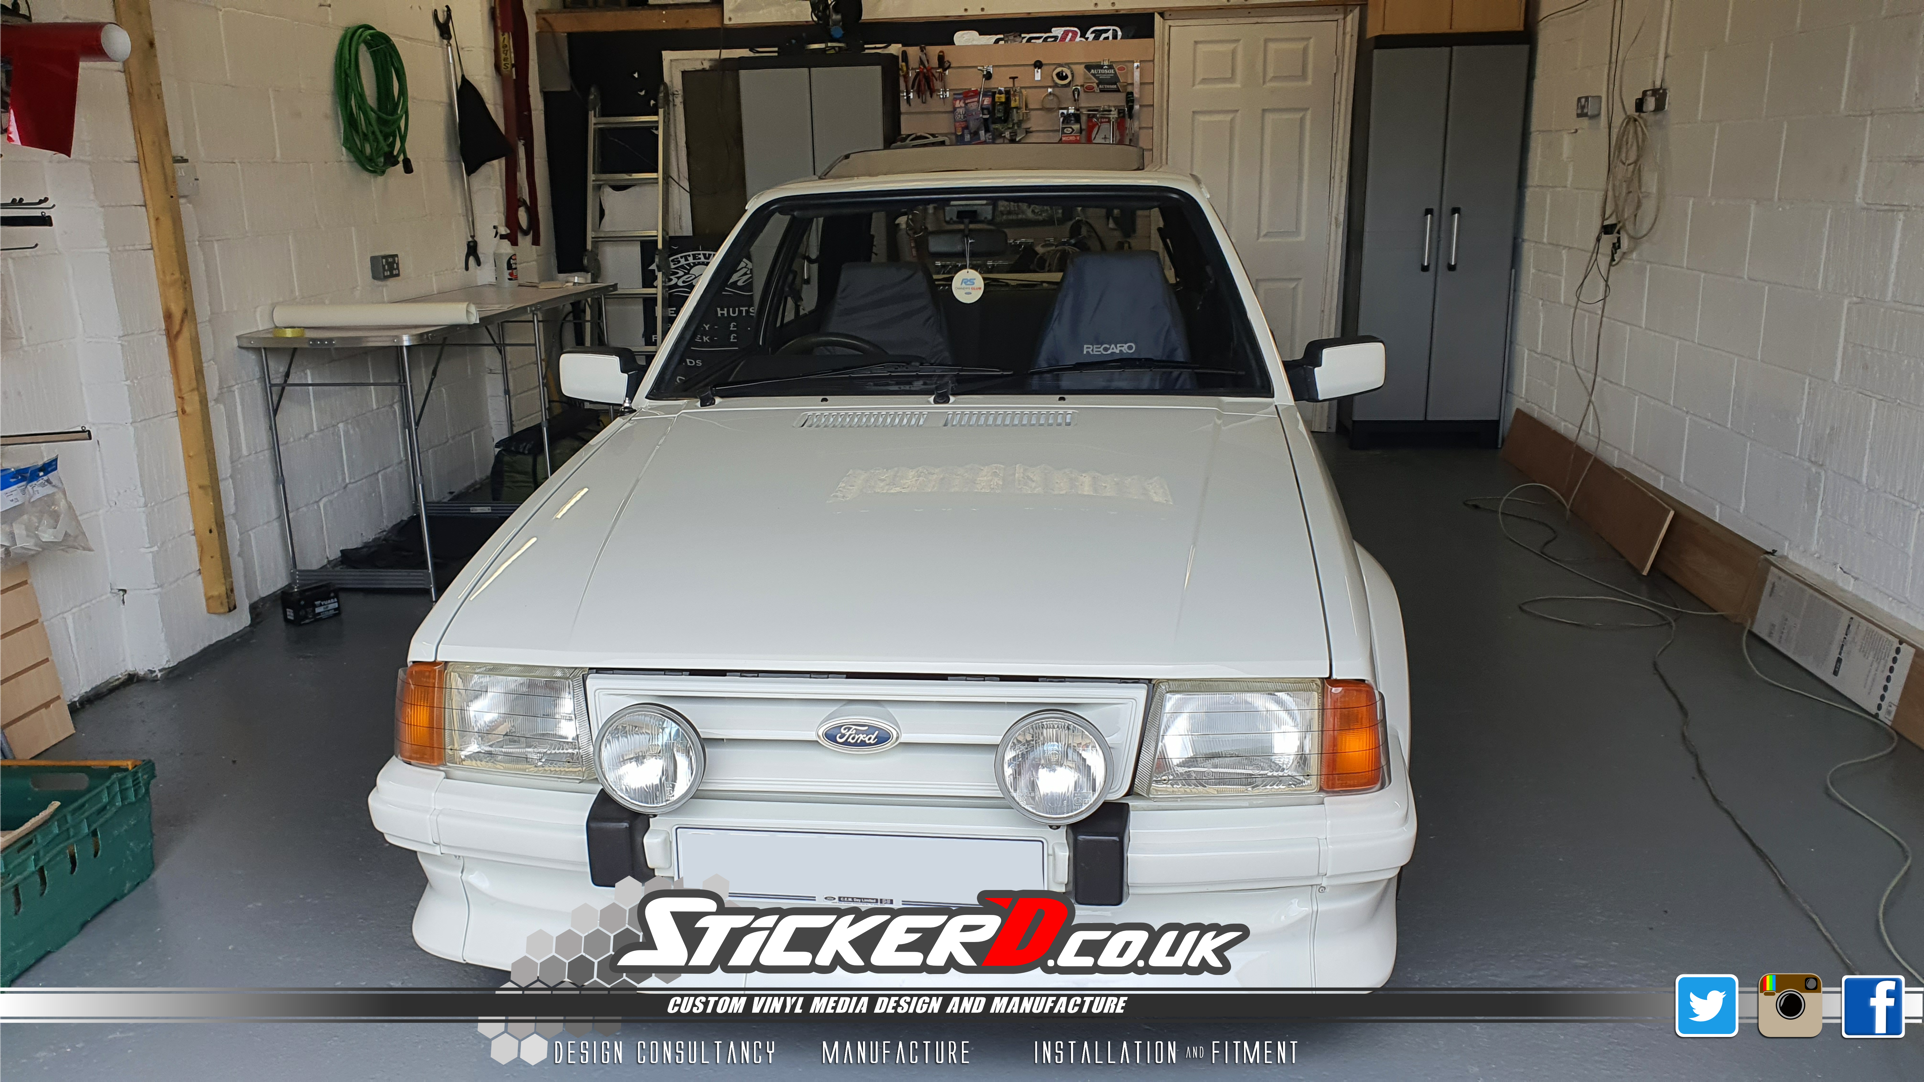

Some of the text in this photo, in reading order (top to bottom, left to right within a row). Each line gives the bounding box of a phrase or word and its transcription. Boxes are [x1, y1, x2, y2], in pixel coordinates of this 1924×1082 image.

[961, 278, 976, 286] RS
[1083, 343, 1136, 355] RECARO
[836, 725, 879, 744] Ford
